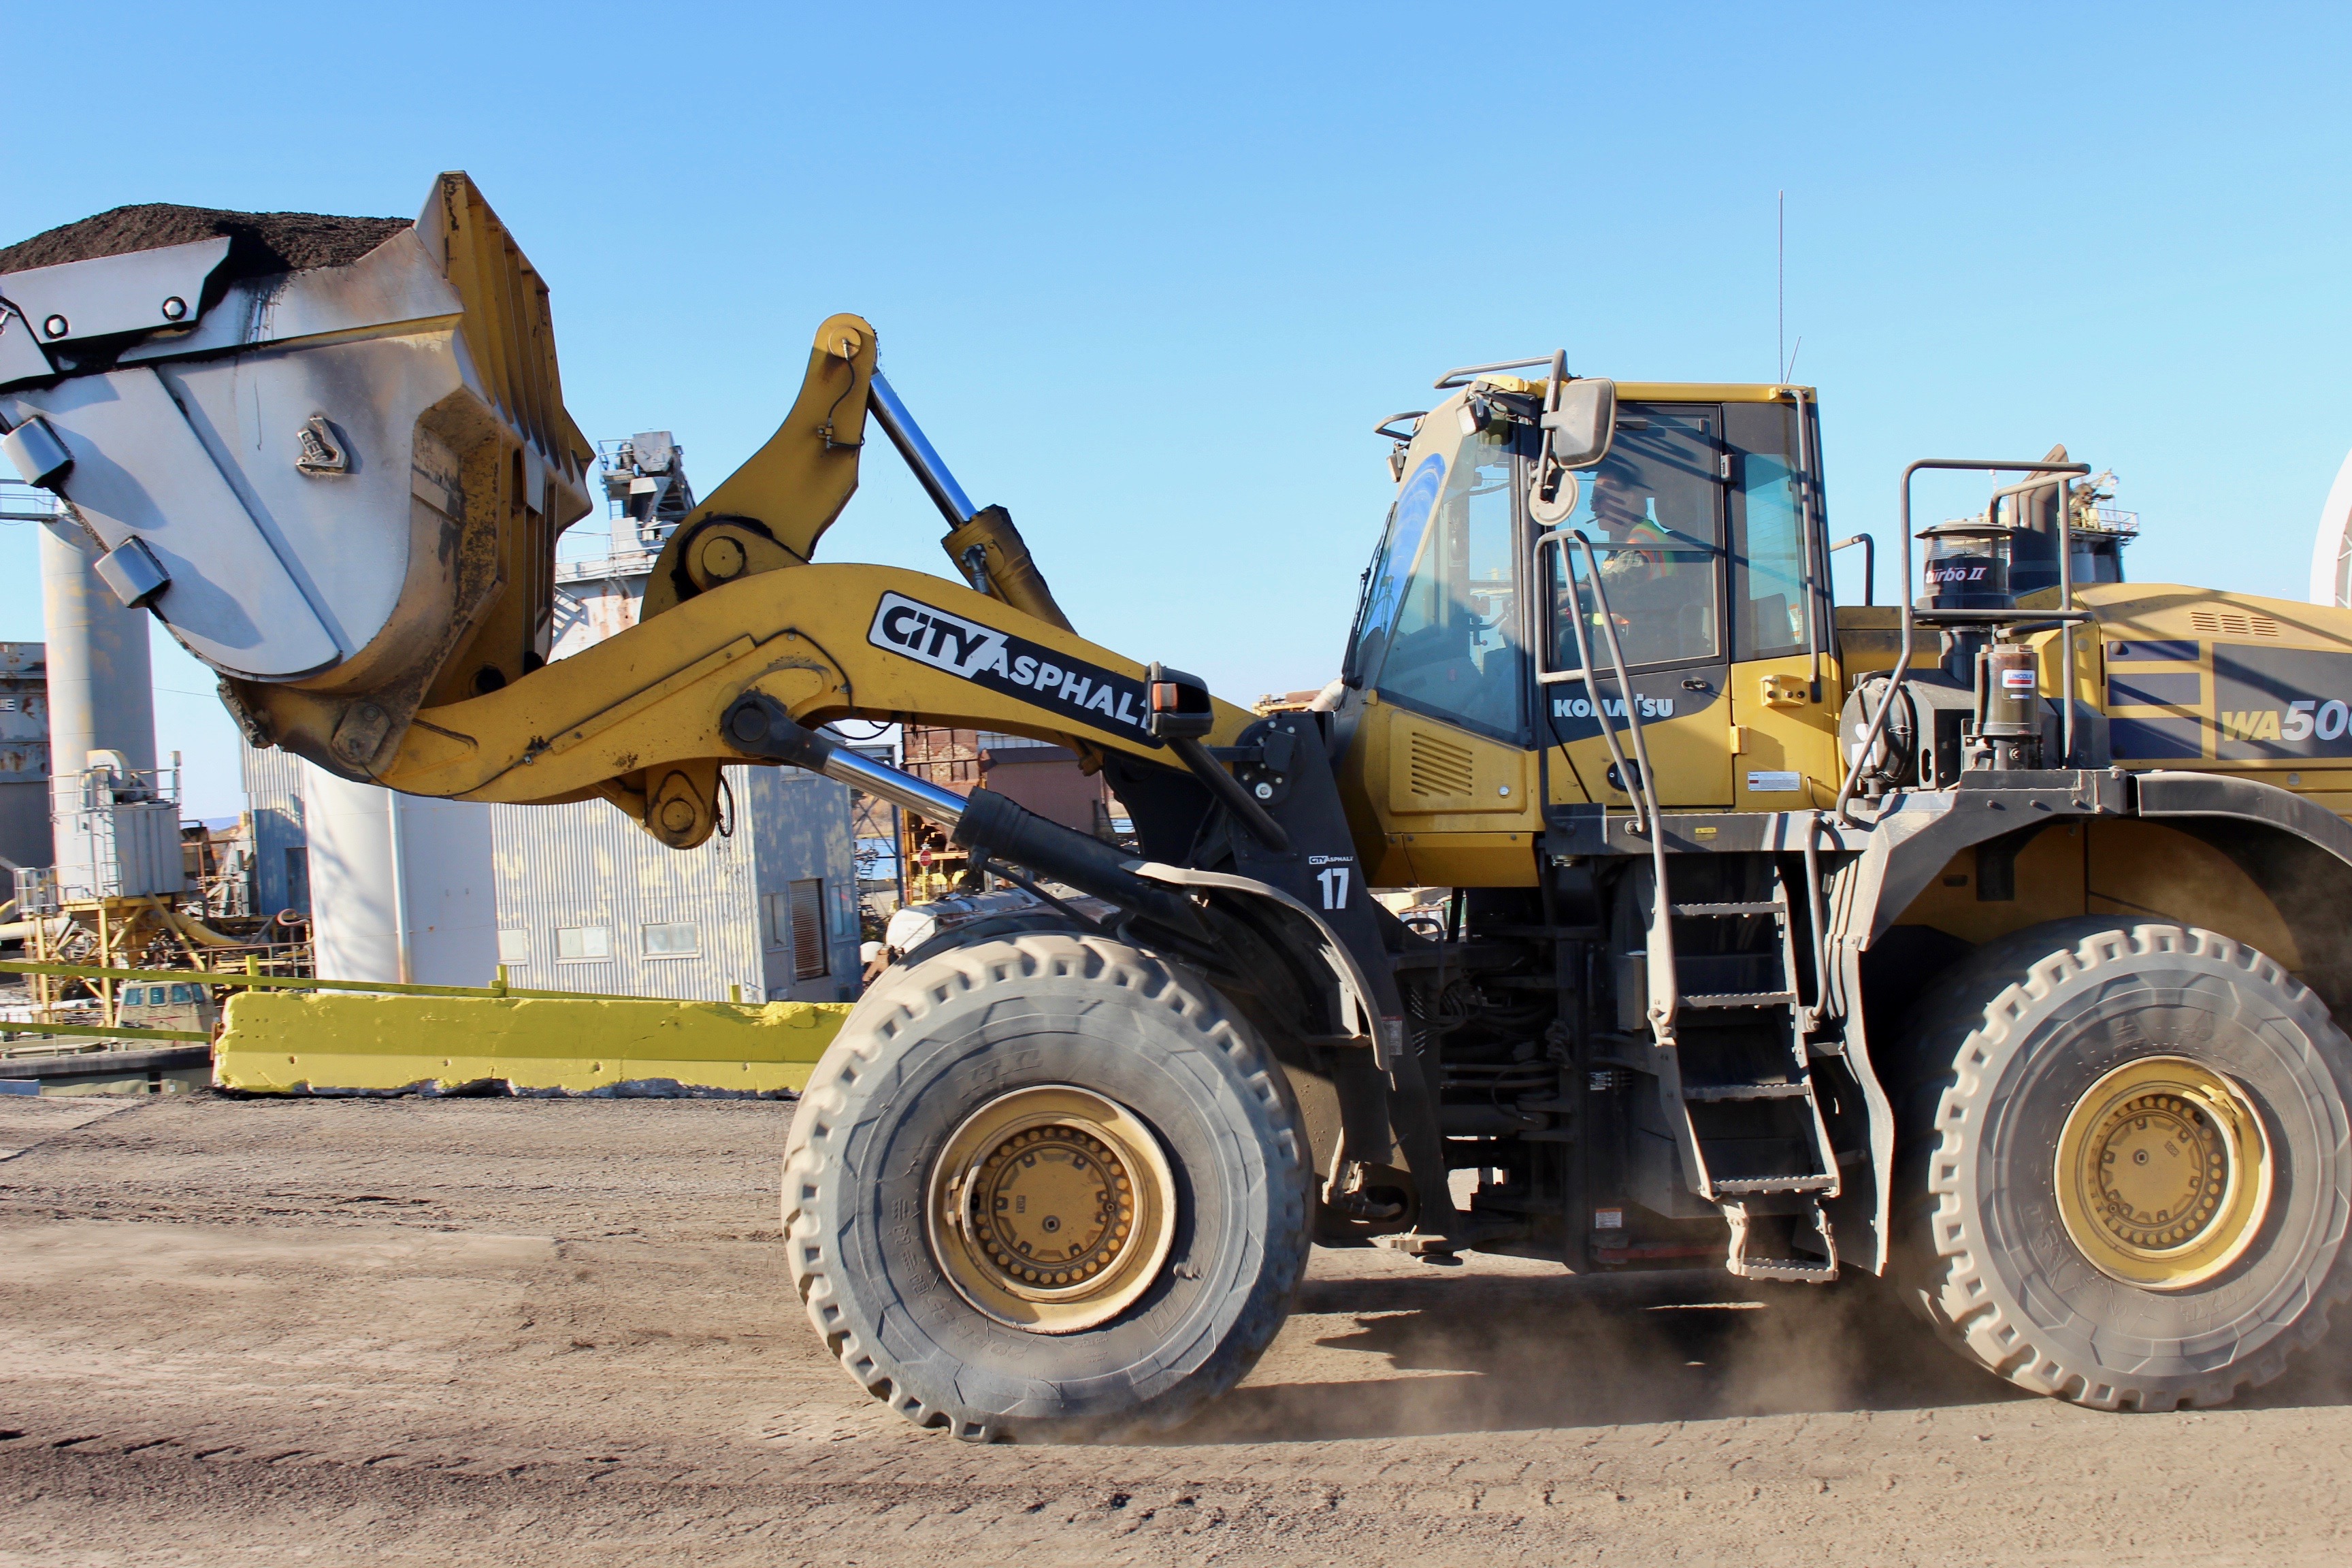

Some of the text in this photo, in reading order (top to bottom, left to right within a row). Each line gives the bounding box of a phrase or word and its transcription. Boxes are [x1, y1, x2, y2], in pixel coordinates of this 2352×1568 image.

[883, 606, 1147, 730] CITY ASPHAL
[2221, 699, 2352, 742] WA50
[1316, 867, 1350, 910] 17
